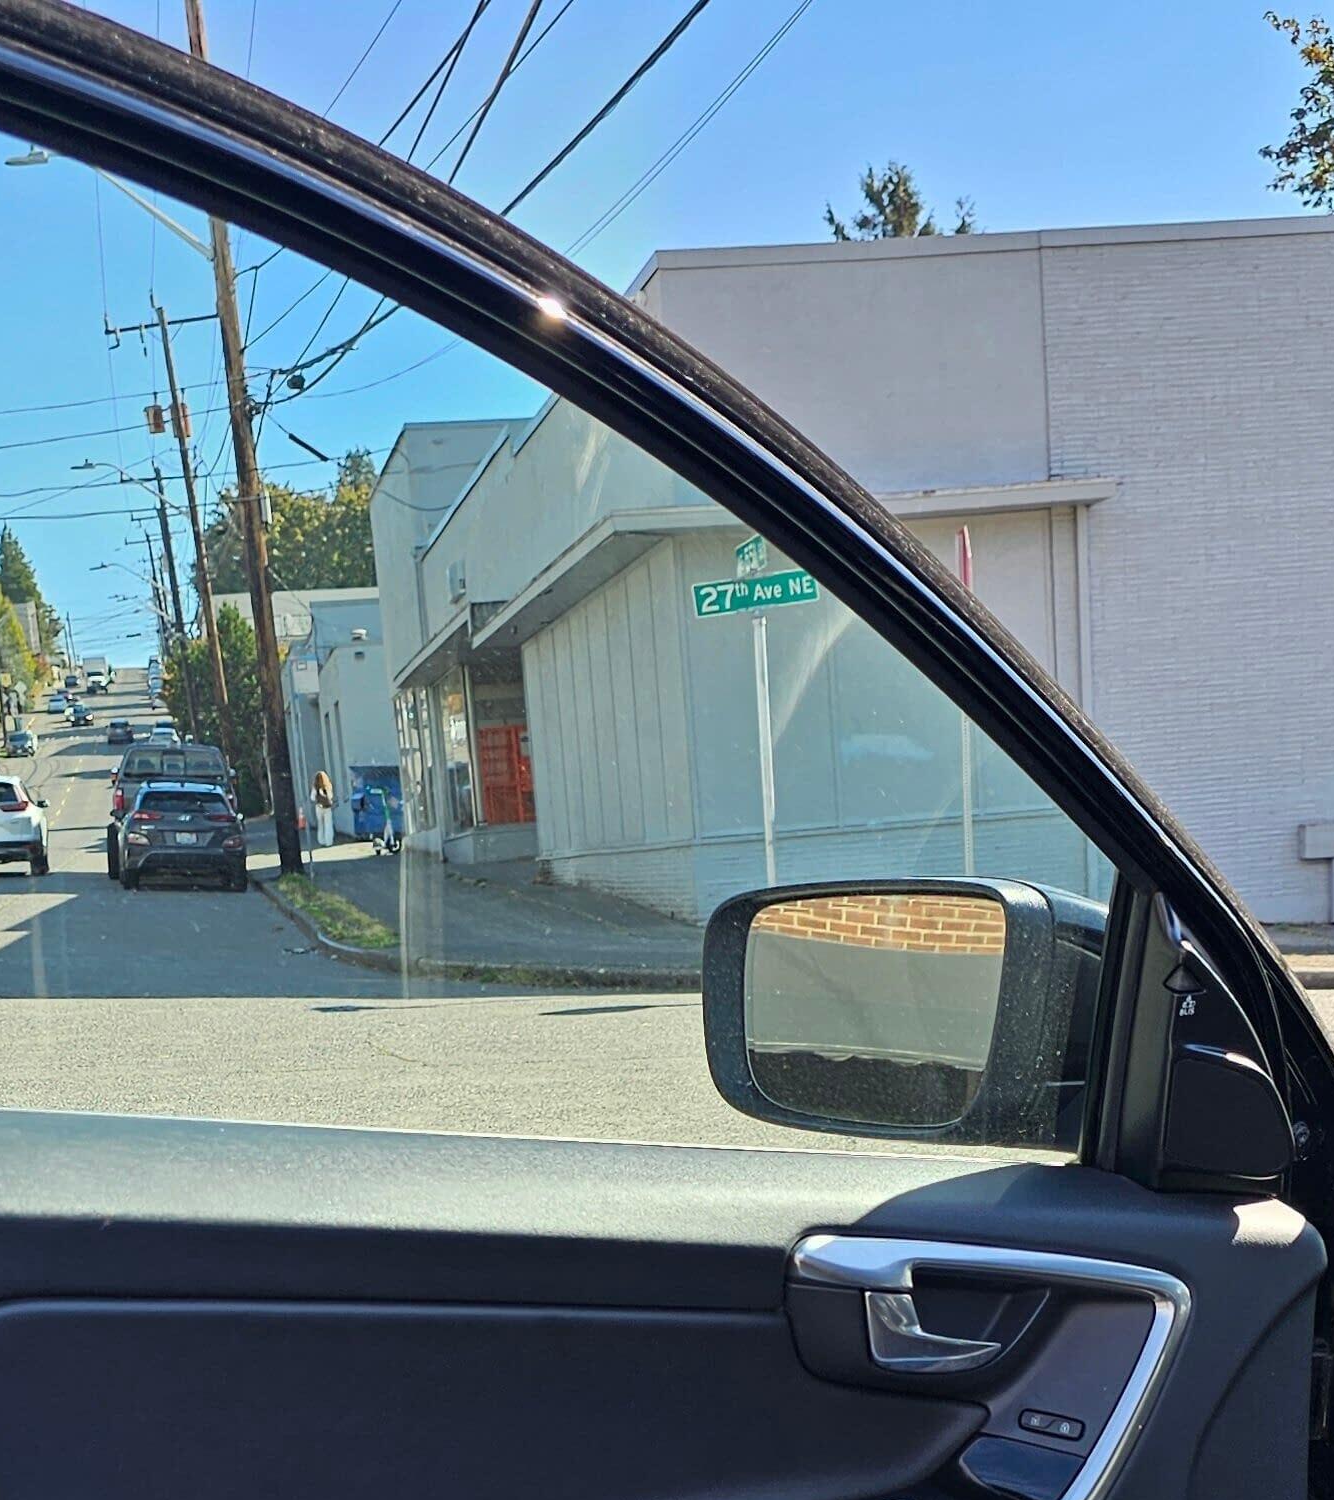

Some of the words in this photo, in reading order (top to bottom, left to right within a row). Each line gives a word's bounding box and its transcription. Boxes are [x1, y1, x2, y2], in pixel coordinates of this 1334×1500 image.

[700, 582, 748, 613] 27th
[753, 583, 782, 601] Ave
[788, 576, 814, 596] NE
